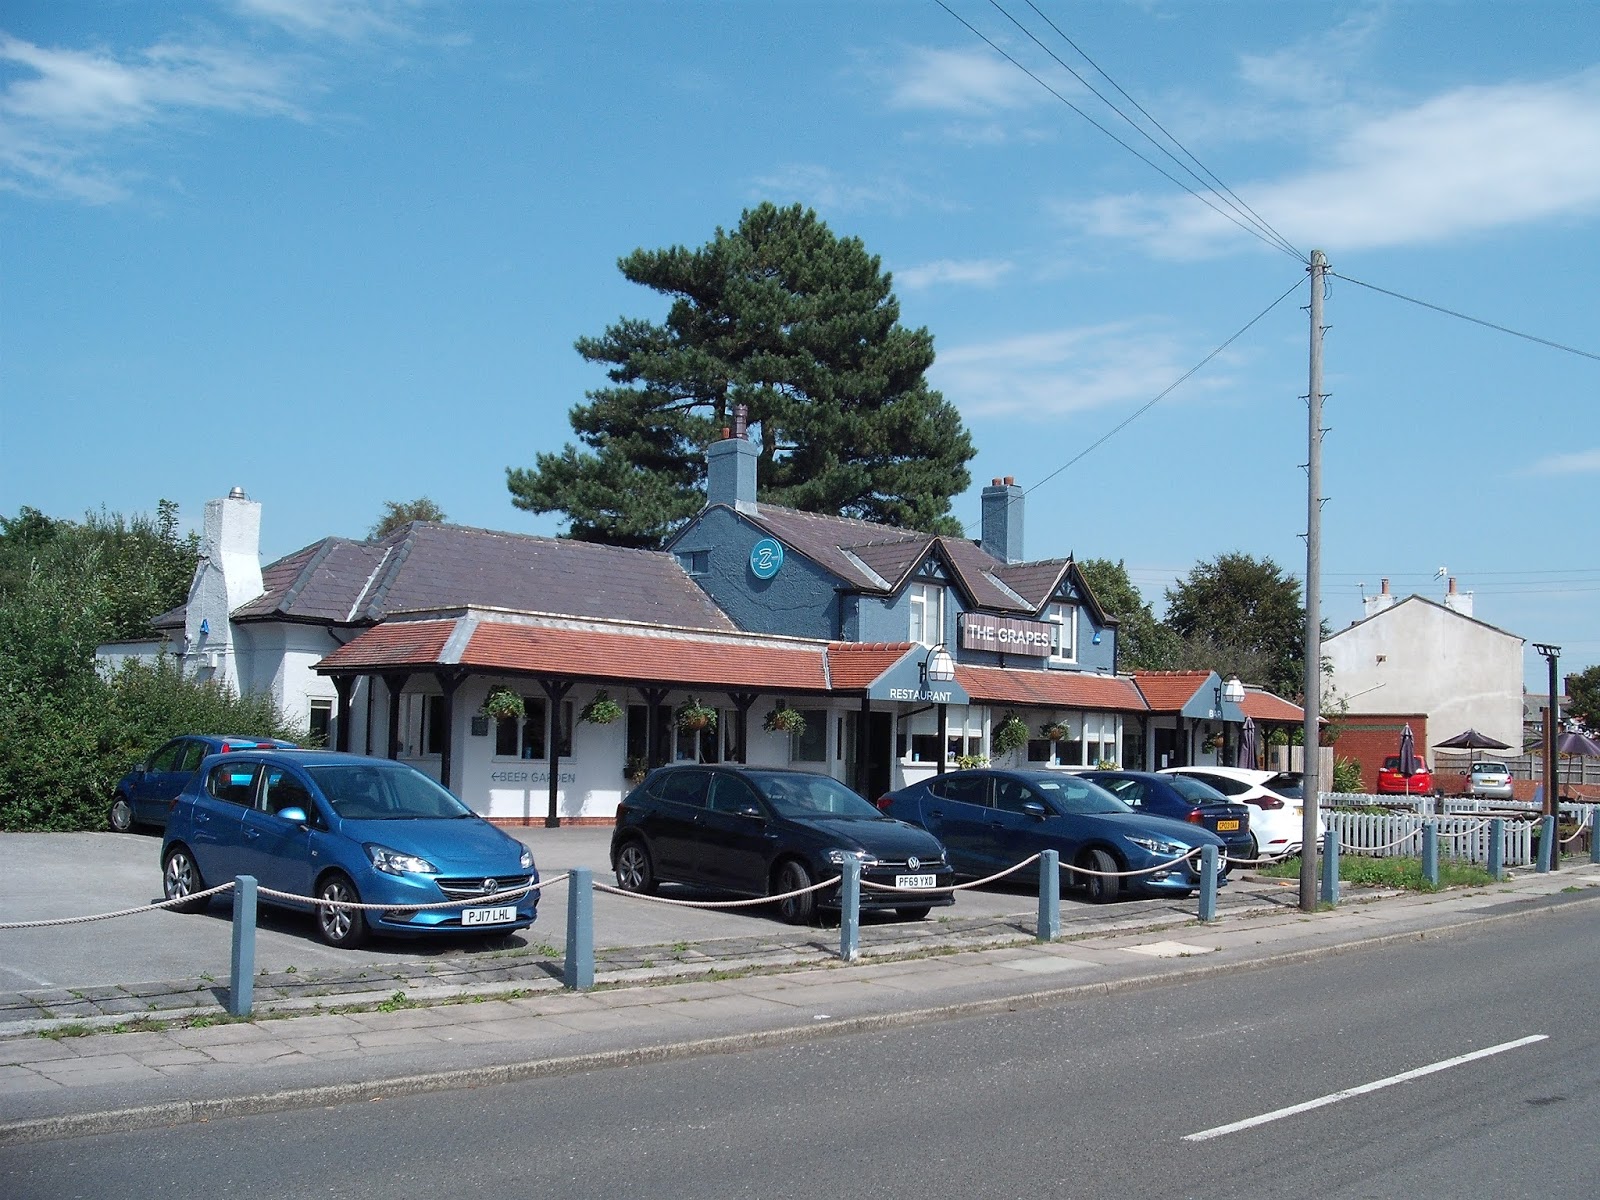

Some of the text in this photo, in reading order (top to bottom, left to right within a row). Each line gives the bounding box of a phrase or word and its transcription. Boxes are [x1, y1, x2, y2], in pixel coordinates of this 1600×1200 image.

[968, 624, 1049, 647] THE GRAPES
[890, 688, 952, 702] RESTAURANT
[500, 771, 528, 782] BEER
[899, 876, 934, 887] PF69 YXD
[469, 909, 510, 923] PJ17 LHL
